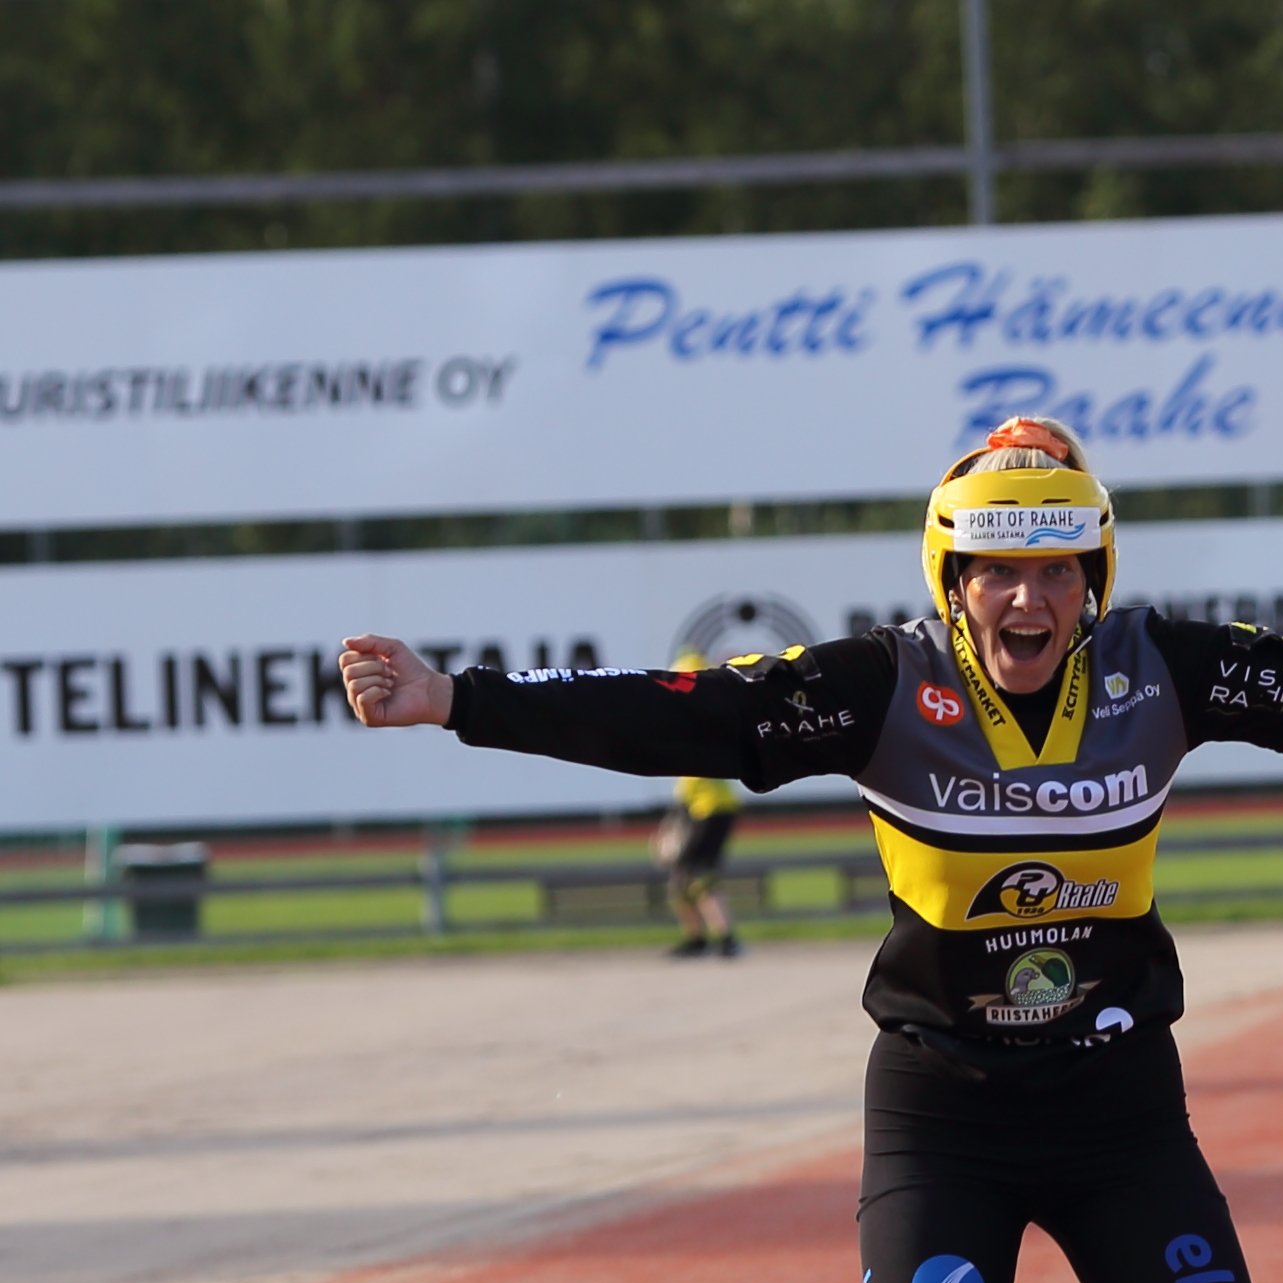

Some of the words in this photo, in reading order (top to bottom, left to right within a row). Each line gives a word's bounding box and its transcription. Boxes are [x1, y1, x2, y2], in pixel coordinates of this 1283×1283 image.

[584, 274, 880, 368] Pentti
[437, 353, 515, 408] OY
[969, 512, 1003, 529] PORT
[1008, 511, 1025, 527] OF
[1031, 511, 1074, 527] RAAHE
[1092, 704, 1110, 720] Veli
[1112, 690, 1143, 716] Seppä
[1144, 684, 1160, 698] Oy
[1057, 879, 1120, 910] Raahe
[986, 926, 1093, 953] HUUMOLAN
